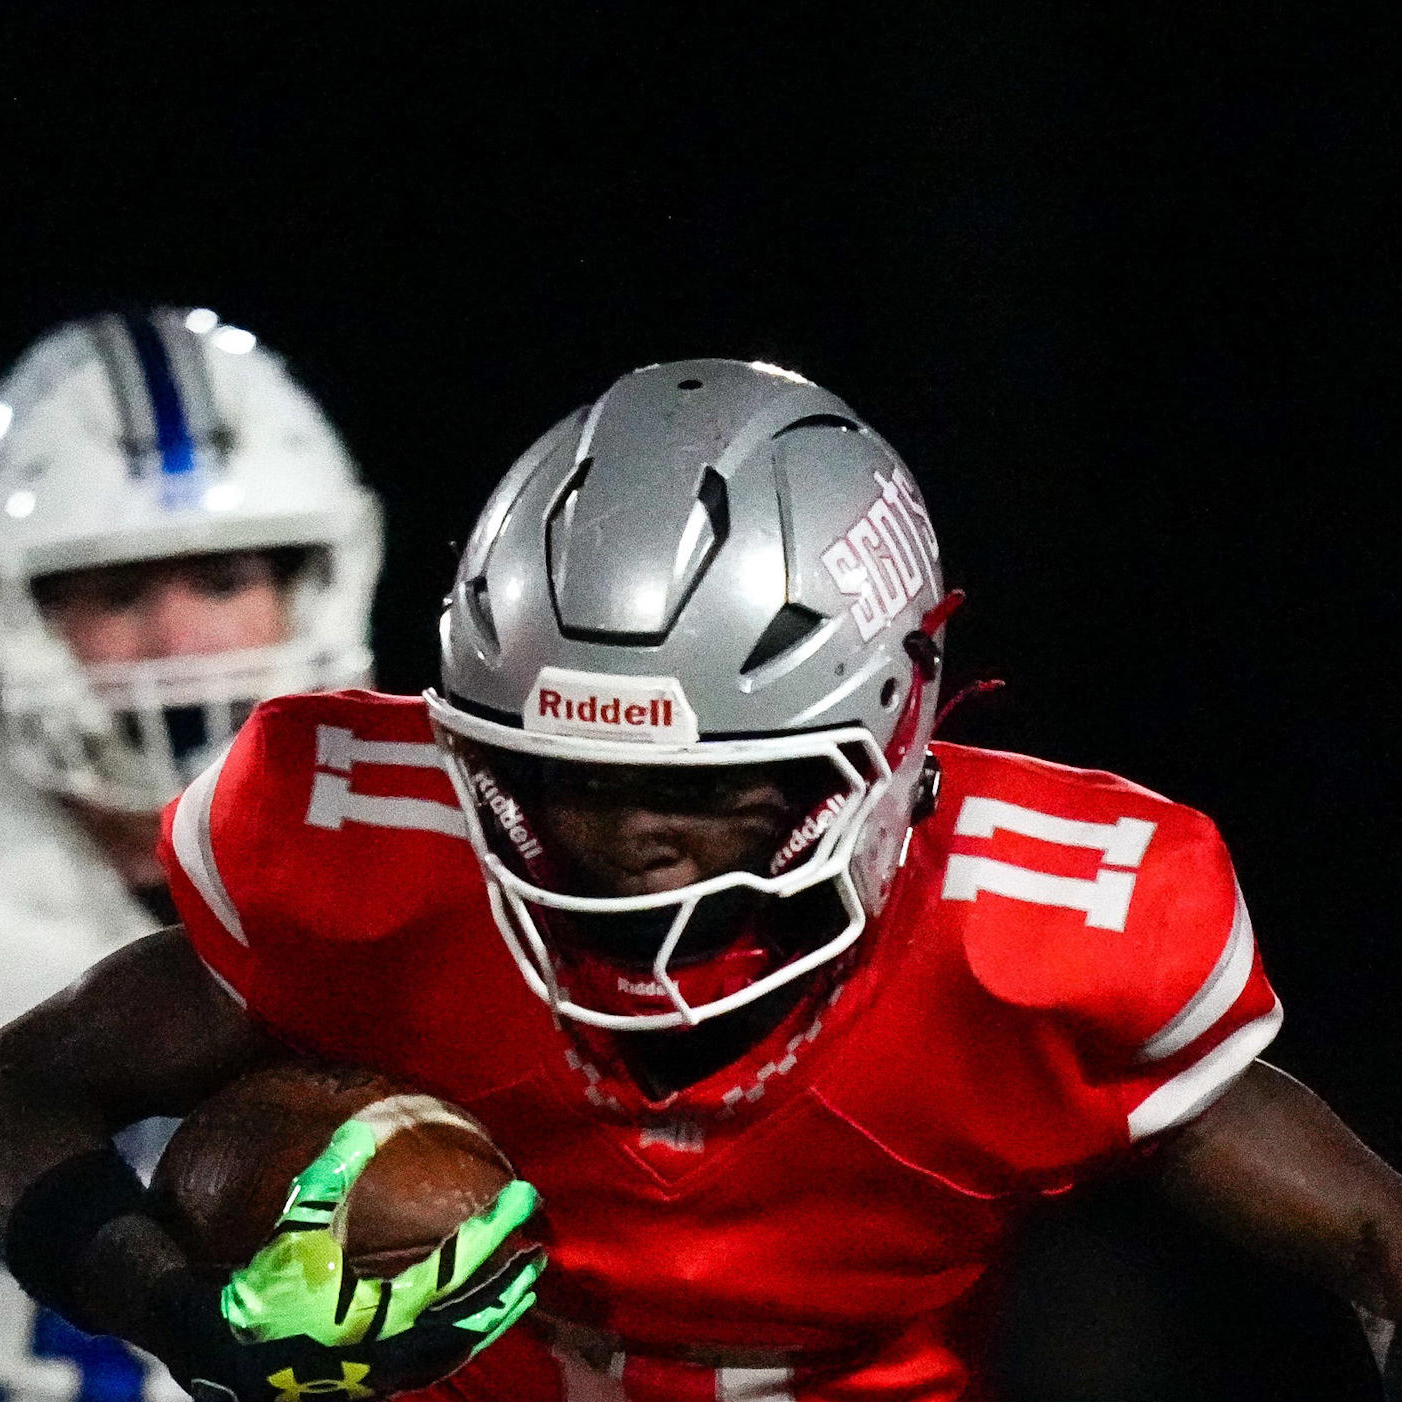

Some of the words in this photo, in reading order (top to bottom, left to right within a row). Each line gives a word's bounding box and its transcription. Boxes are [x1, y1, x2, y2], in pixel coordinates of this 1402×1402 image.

[820, 466, 940, 643] SCOTS
[539, 688, 673, 727] Riddell
[304, 724, 470, 840] 11
[941, 796, 1158, 933] 11
